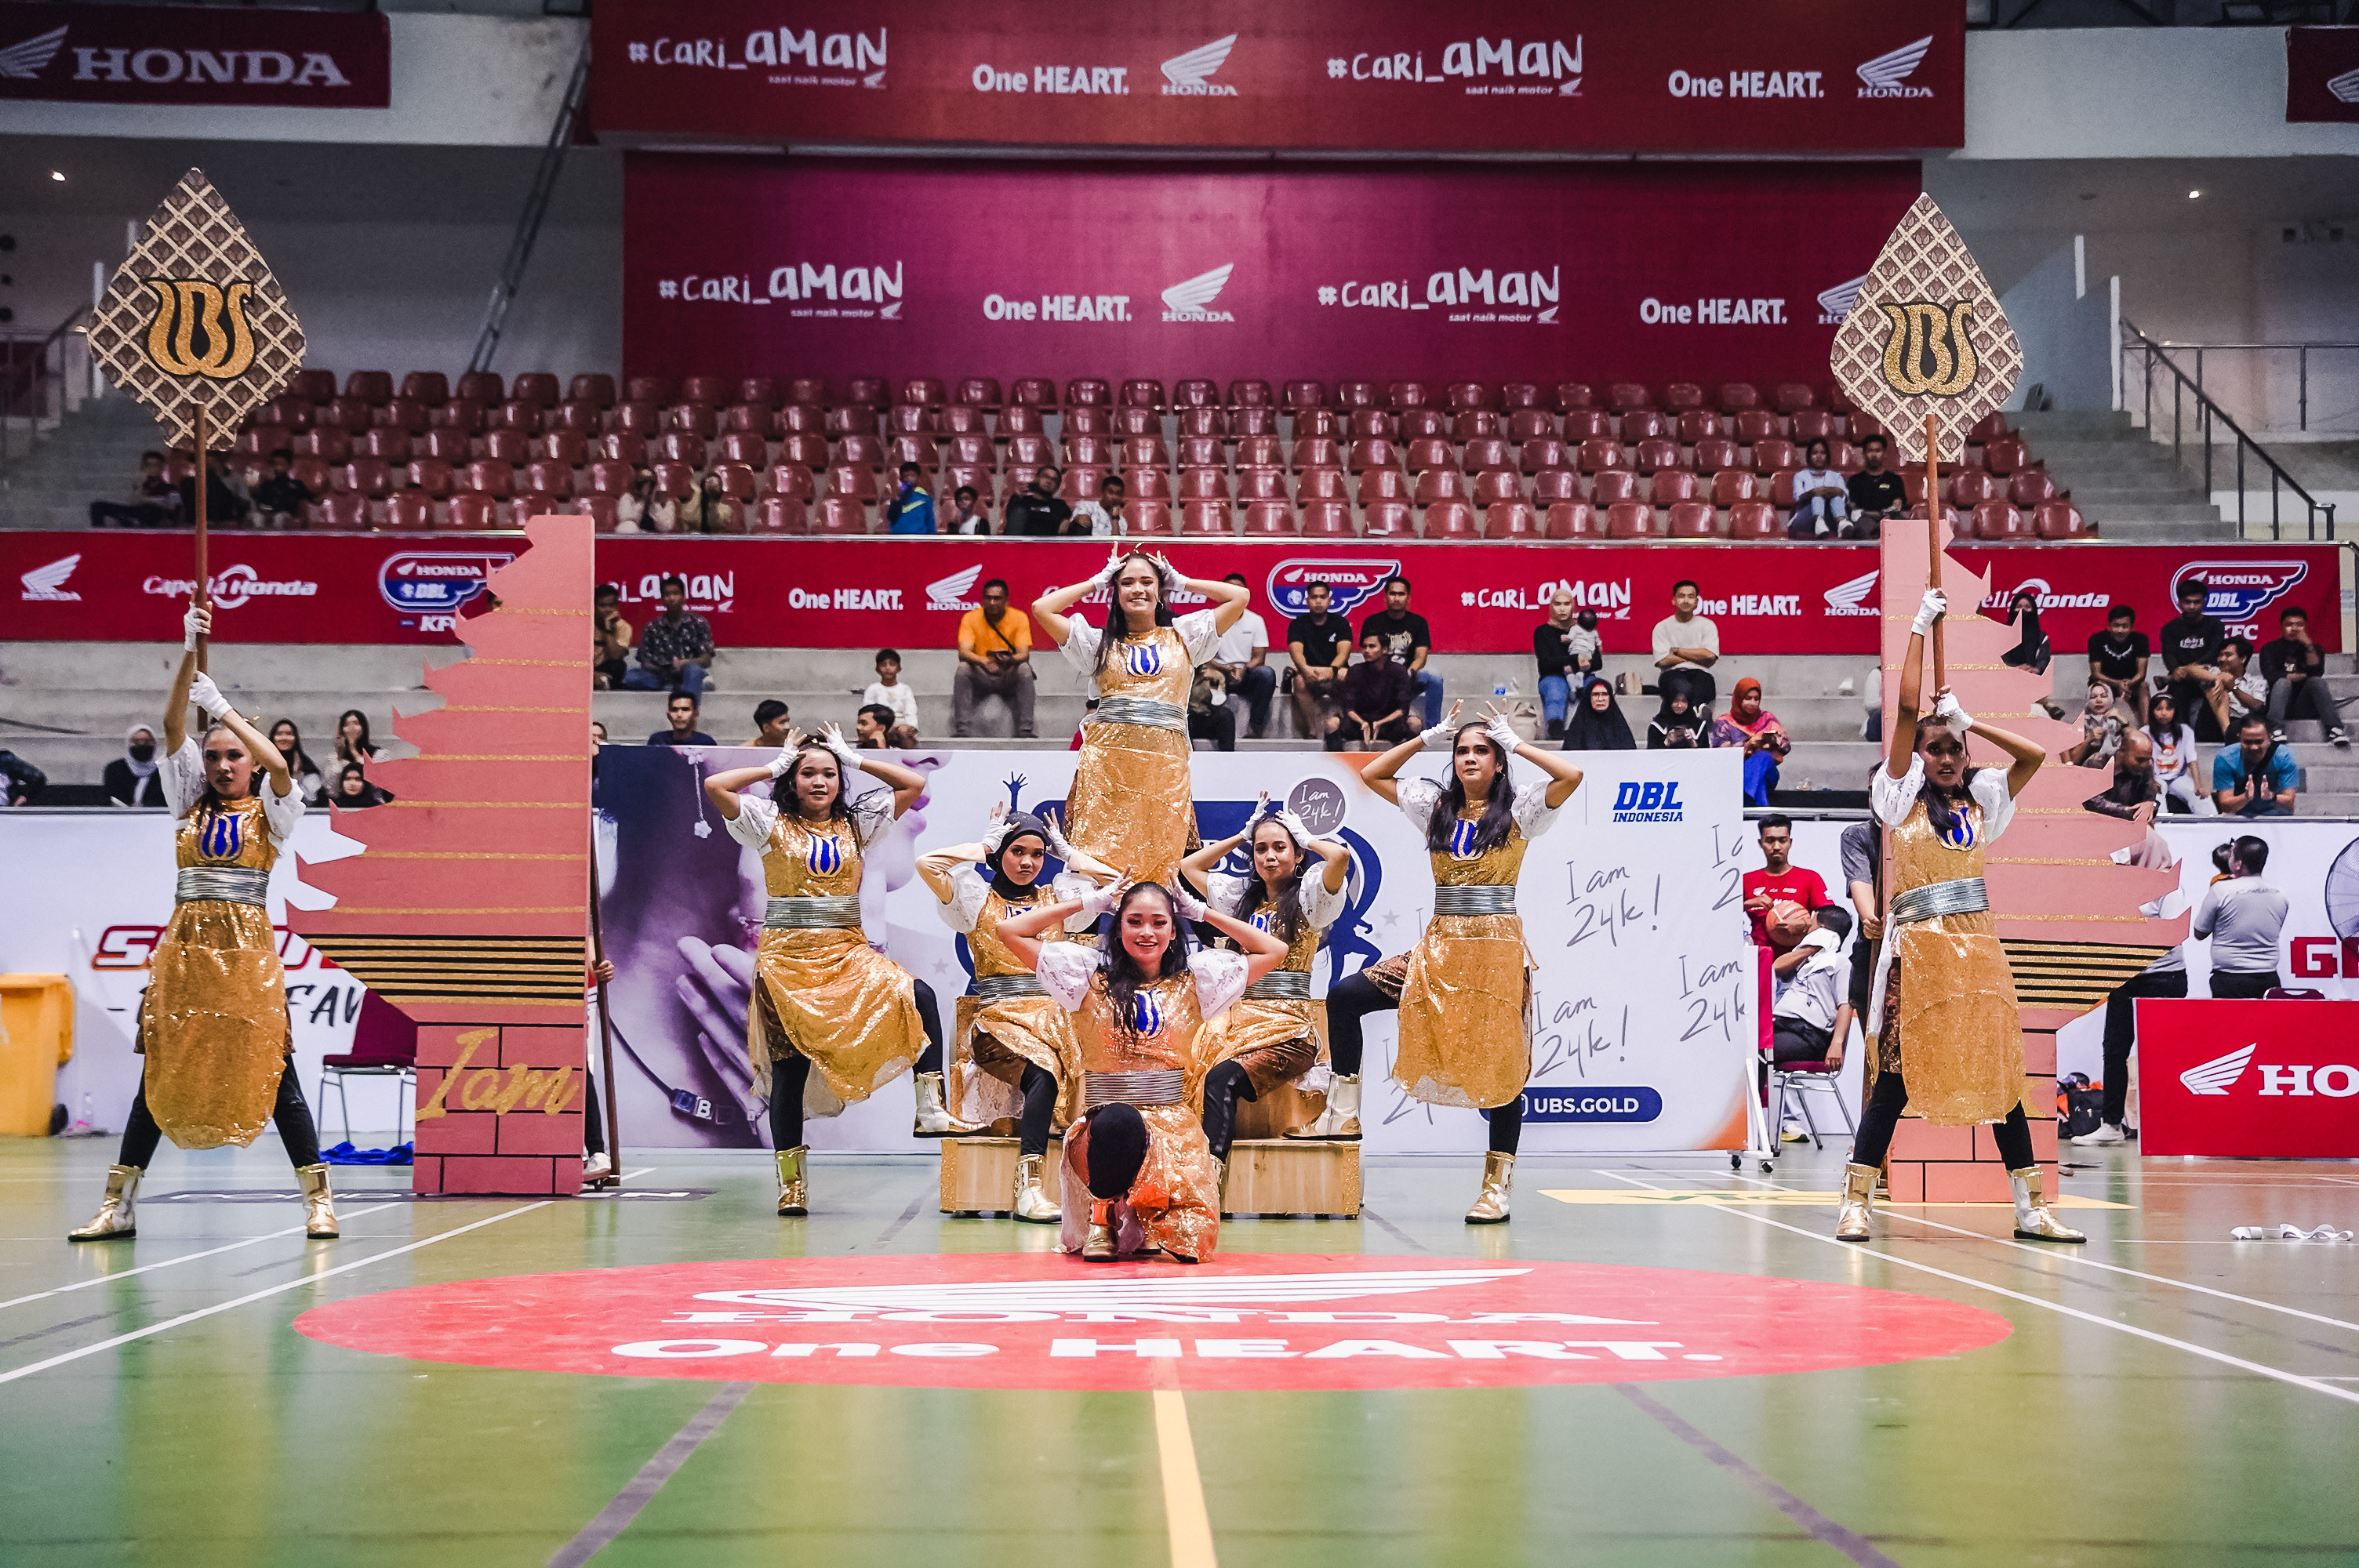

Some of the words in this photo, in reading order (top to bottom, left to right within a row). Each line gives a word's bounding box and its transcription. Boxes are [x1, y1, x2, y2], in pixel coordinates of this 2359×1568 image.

[72, 45, 352, 87] HONDA
[972, 64, 1028, 93] One
[1034, 66, 1130, 95] HEART.
[1161, 84, 1239, 96] HONDA
[1668, 69, 1724, 98] One
[1728, 71, 1825, 99] HEART.
[1856, 86, 1935, 99] HONDA
[983, 293, 1038, 321] One
[1041, 295, 1133, 322] HEART.
[1161, 311, 1235, 322] HONDA
[1640, 297, 1692, 324] One
[1697, 299, 1787, 325] HEART.
[416, 565, 483, 576] HONDA
[1303, 572, 1369, 583] HONDA
[2208, 575, 2274, 585] HONDA
[788, 587, 831, 609] One
[834, 589, 903, 611] HEART.
[1731, 595, 1801, 616] HEART.
[2206, 592, 2241, 608] DBL
[1824, 607, 1882, 616] HONDA
[1299, 785, 1309, 804] I
[1309, 789, 1329, 800] am
[1612, 782, 1683, 811] DBL
[1612, 811, 1683, 822] INDONESIA
[1566, 860, 1581, 905] I
[1586, 866, 1630, 893] am
[1679, 954, 1695, 1000] I
[1699, 960, 1743, 988] am
[1534, 991, 1548, 1036] I
[1554, 996, 1598, 1023] am
[1679, 982, 1746, 1042] 24k
[461, 1062, 580, 1116] am
[1534, 1097, 1640, 1114] UBS.GOLD
[661, 1310, 1660, 1325] HONDA
[611, 1338, 1000, 1359] One
[1049, 1338, 1724, 1362] HEART.
